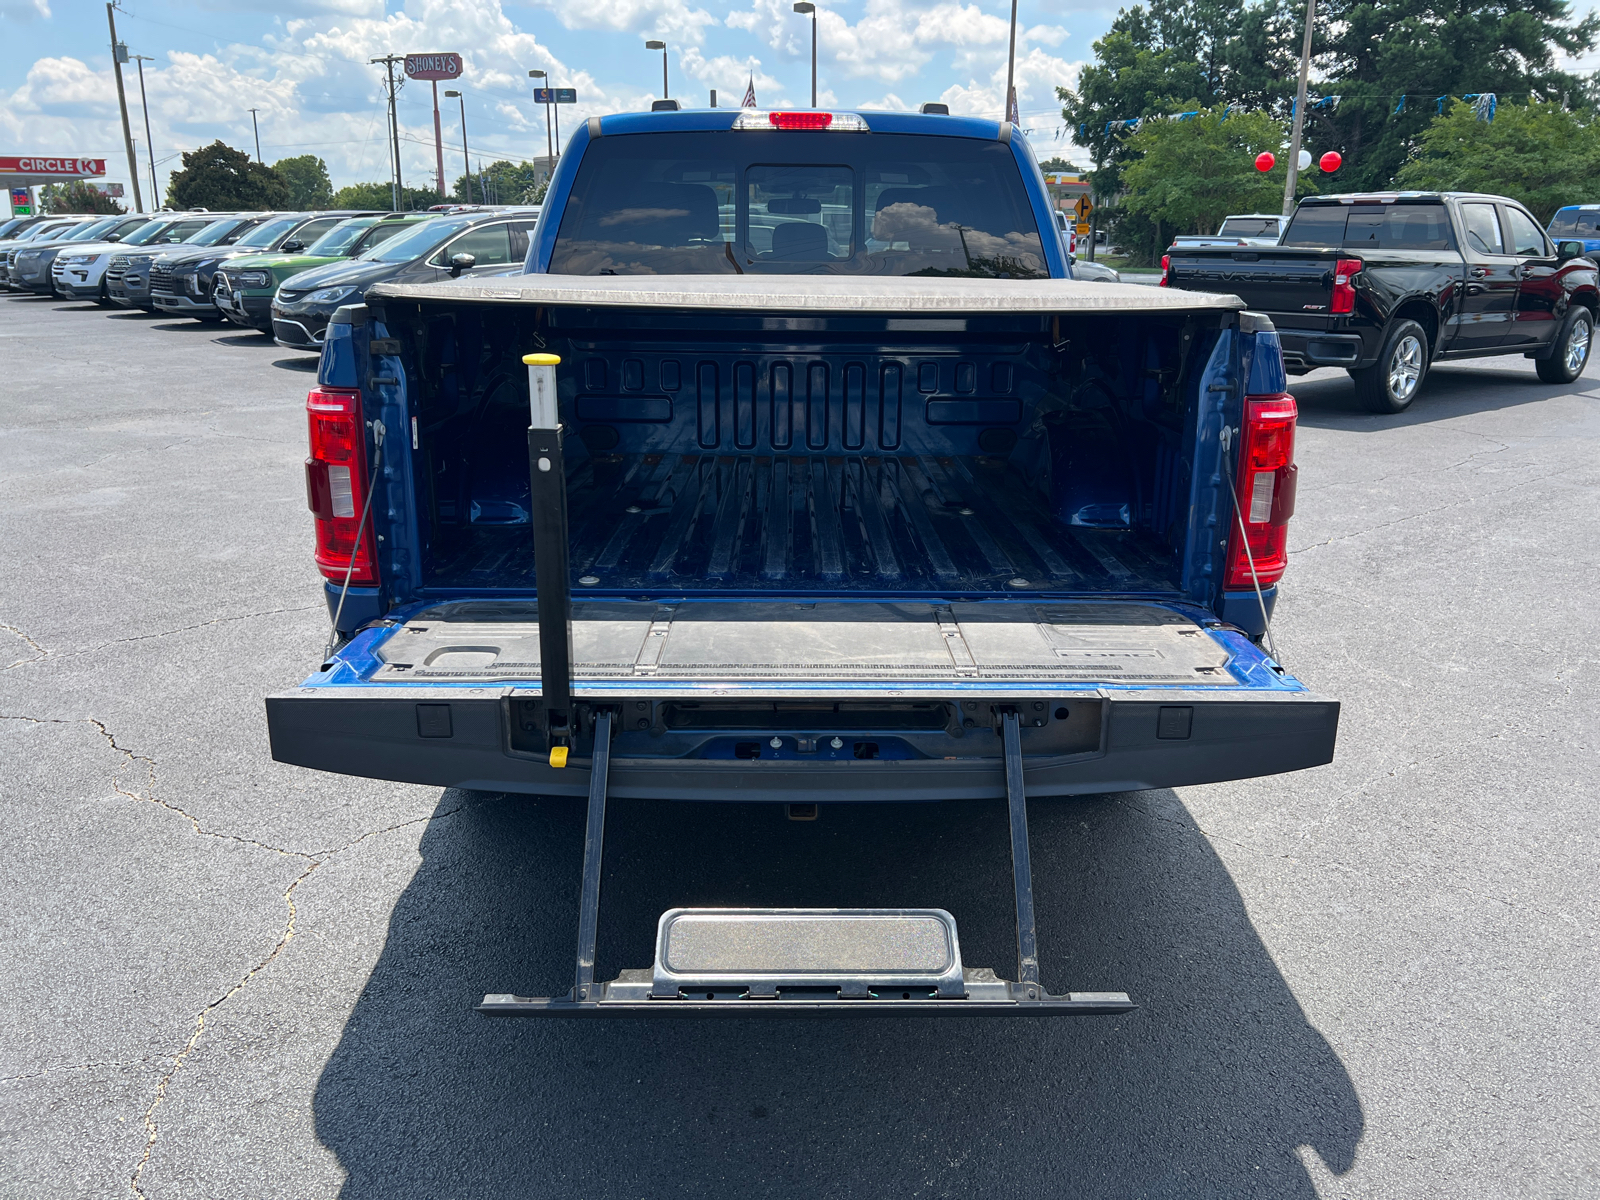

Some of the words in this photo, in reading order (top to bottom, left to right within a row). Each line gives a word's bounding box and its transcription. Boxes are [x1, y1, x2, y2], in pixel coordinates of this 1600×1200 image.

[407, 56, 457, 75] SHONEY'S
[19, 159, 74, 171] CIRCLE
[79, 159, 96, 174] K
